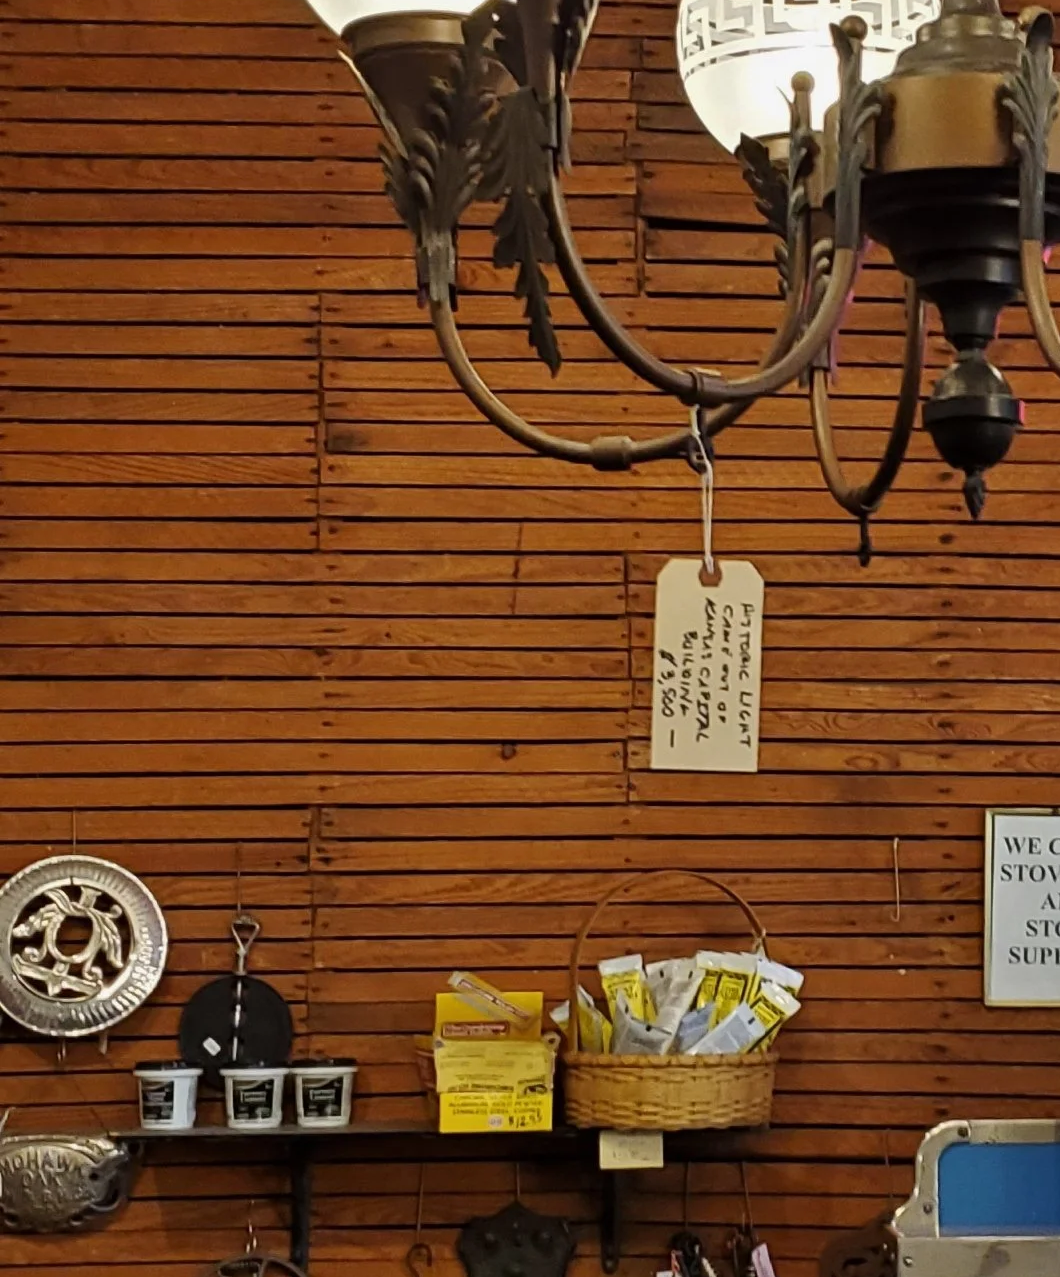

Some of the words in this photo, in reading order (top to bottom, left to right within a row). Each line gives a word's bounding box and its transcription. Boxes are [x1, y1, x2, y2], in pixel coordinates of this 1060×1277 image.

[680, 630, 698, 717] BUILDING
[738, 691, 754, 748] LIGHT
[1003, 837, 1042, 856] WE
